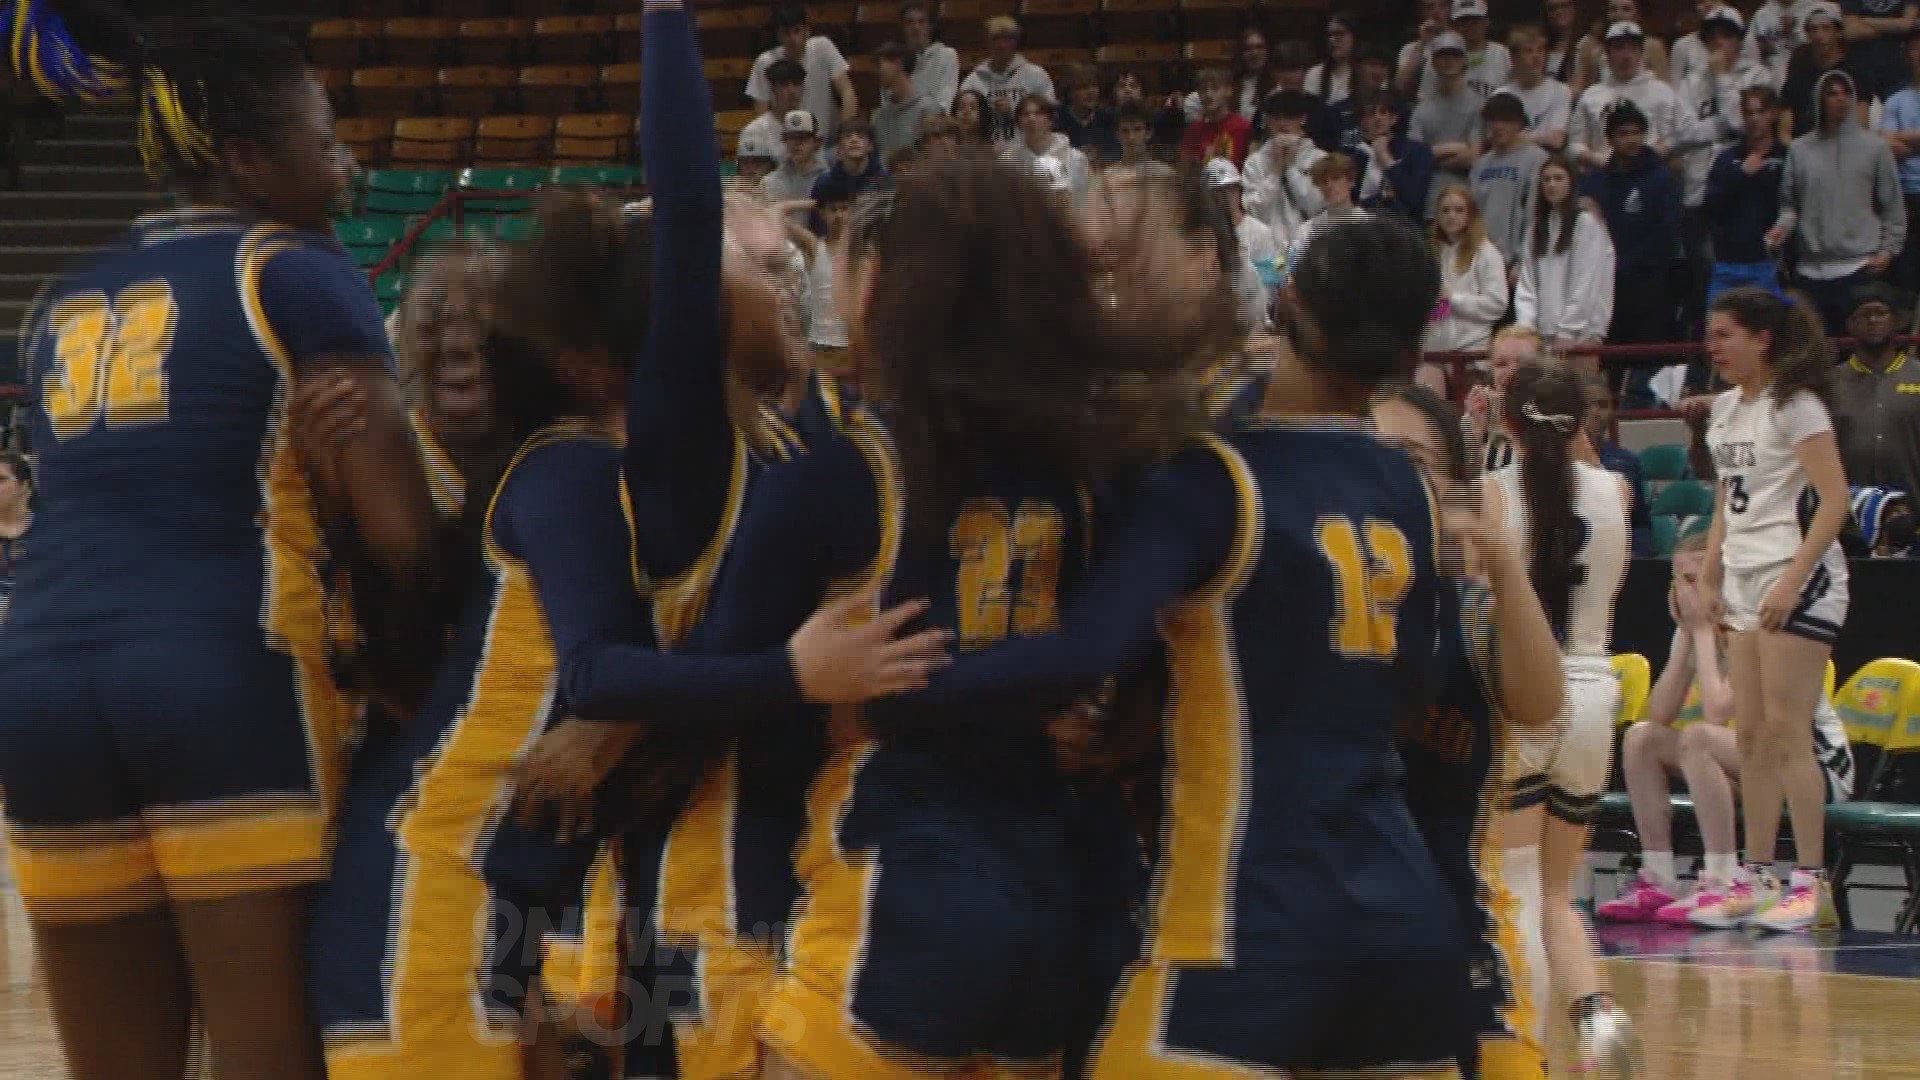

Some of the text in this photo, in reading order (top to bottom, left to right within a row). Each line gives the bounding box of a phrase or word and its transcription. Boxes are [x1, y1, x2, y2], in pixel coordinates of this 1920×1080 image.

[42, 278, 179, 441] 32
[950, 499, 1064, 651] 23
[1314, 514, 1416, 662] 12
